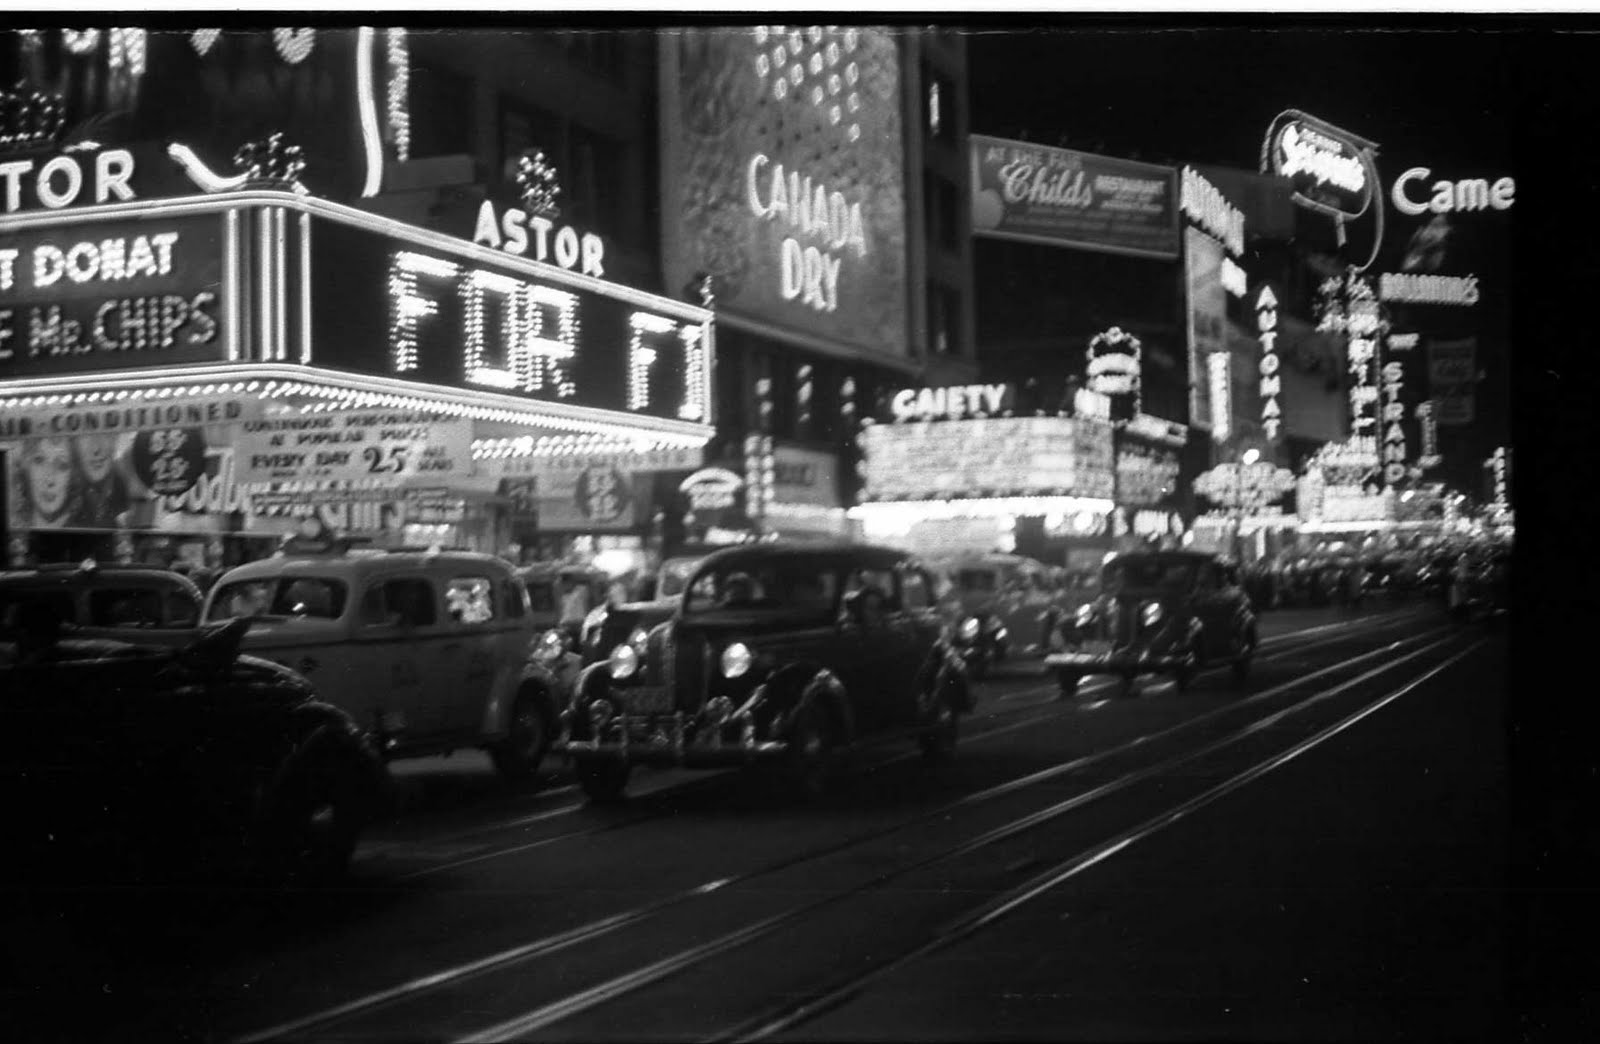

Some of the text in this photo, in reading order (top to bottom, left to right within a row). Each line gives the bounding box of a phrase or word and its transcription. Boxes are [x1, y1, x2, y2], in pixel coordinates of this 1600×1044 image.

[749, 154, 866, 258] CANADA
[998, 159, 1093, 208] Childs
[1391, 167, 1515, 216] Came
[34, 231, 178, 287] DONAT
[473, 200, 605, 277] ASTOR
[780, 238, 841, 312] DRY
[93, 292, 215, 350] CHIPS
[388, 251, 581, 398] FOR
[1255, 285, 1281, 440] AUTOMAT
[51, 401, 241, 432] CONDITIONED
[892, 383, 1006, 418] GAIETY
[1382, 362, 1407, 484] STRAND
